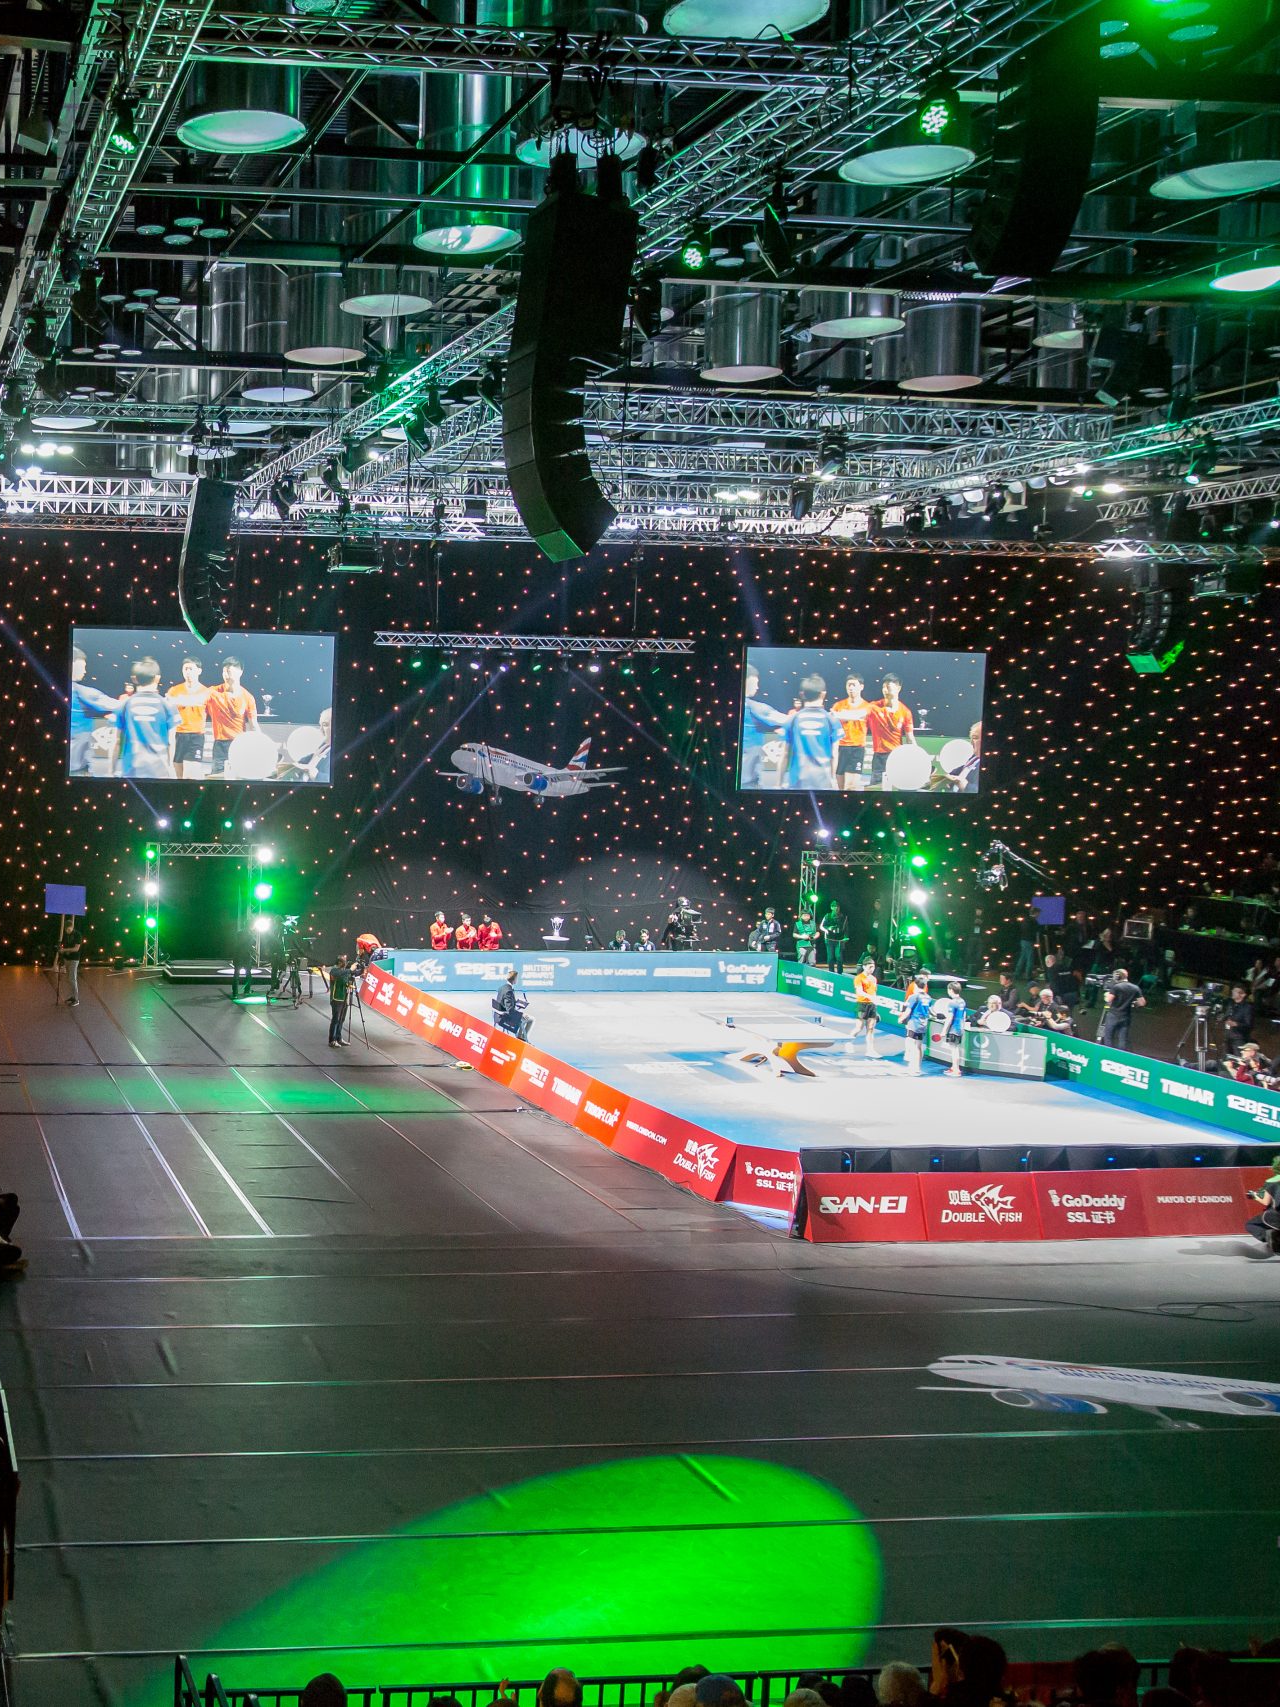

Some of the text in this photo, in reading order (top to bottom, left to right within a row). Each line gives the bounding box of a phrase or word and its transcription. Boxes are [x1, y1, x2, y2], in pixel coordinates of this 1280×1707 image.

[672, 1152, 698, 1173] DOUBLE
[755, 1179, 775, 1189] SSL
[819, 1195, 908, 1214] SAN-EI
[1061, 1194, 1126, 1211] GoDaddy
[1156, 1195, 1233, 1204] MAYOR OF LONDON
[941, 1209, 986, 1223] DOUBLE
[999, 1211, 1023, 1223] FISH
[1066, 1210, 1116, 1225] SSL 证书
